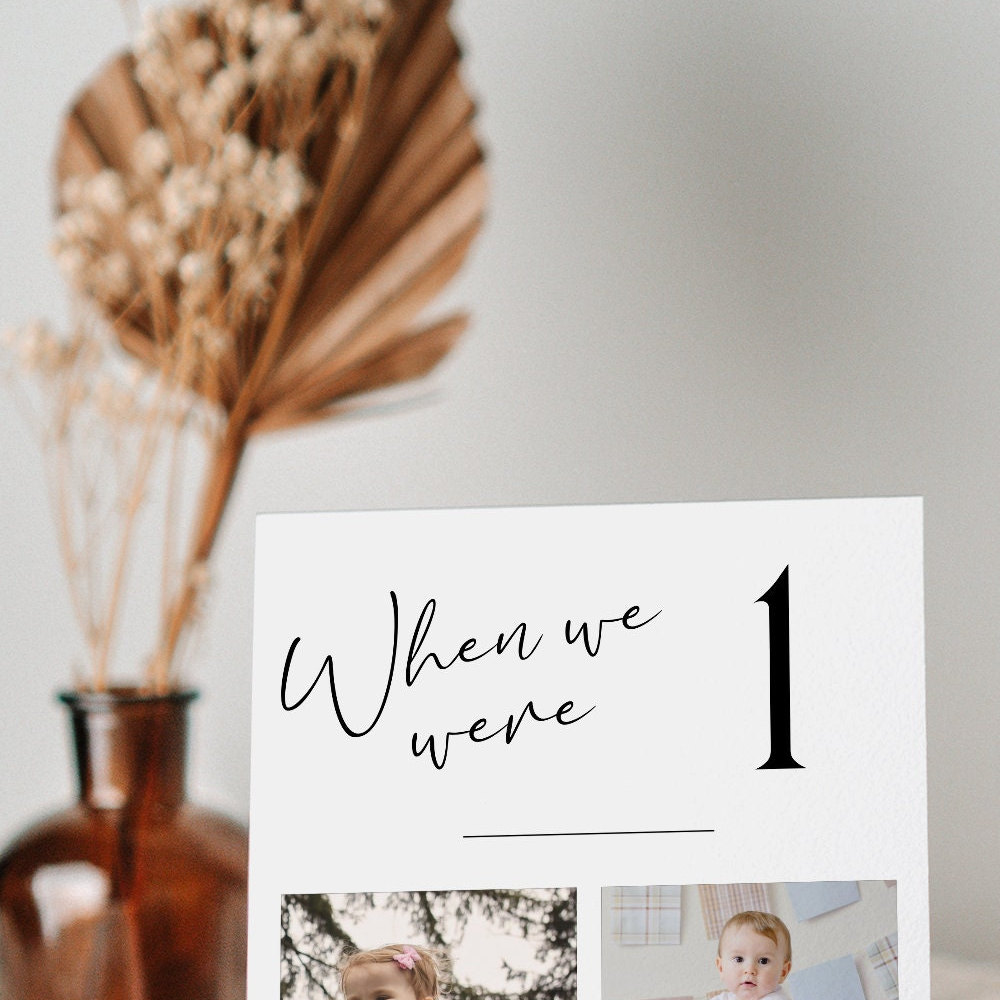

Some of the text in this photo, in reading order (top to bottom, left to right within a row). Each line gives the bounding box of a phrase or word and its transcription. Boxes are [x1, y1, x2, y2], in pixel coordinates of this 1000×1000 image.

[281, 591, 663, 738] When we
[411, 700, 597, 771] were
[754, 565, 807, 771] 1
